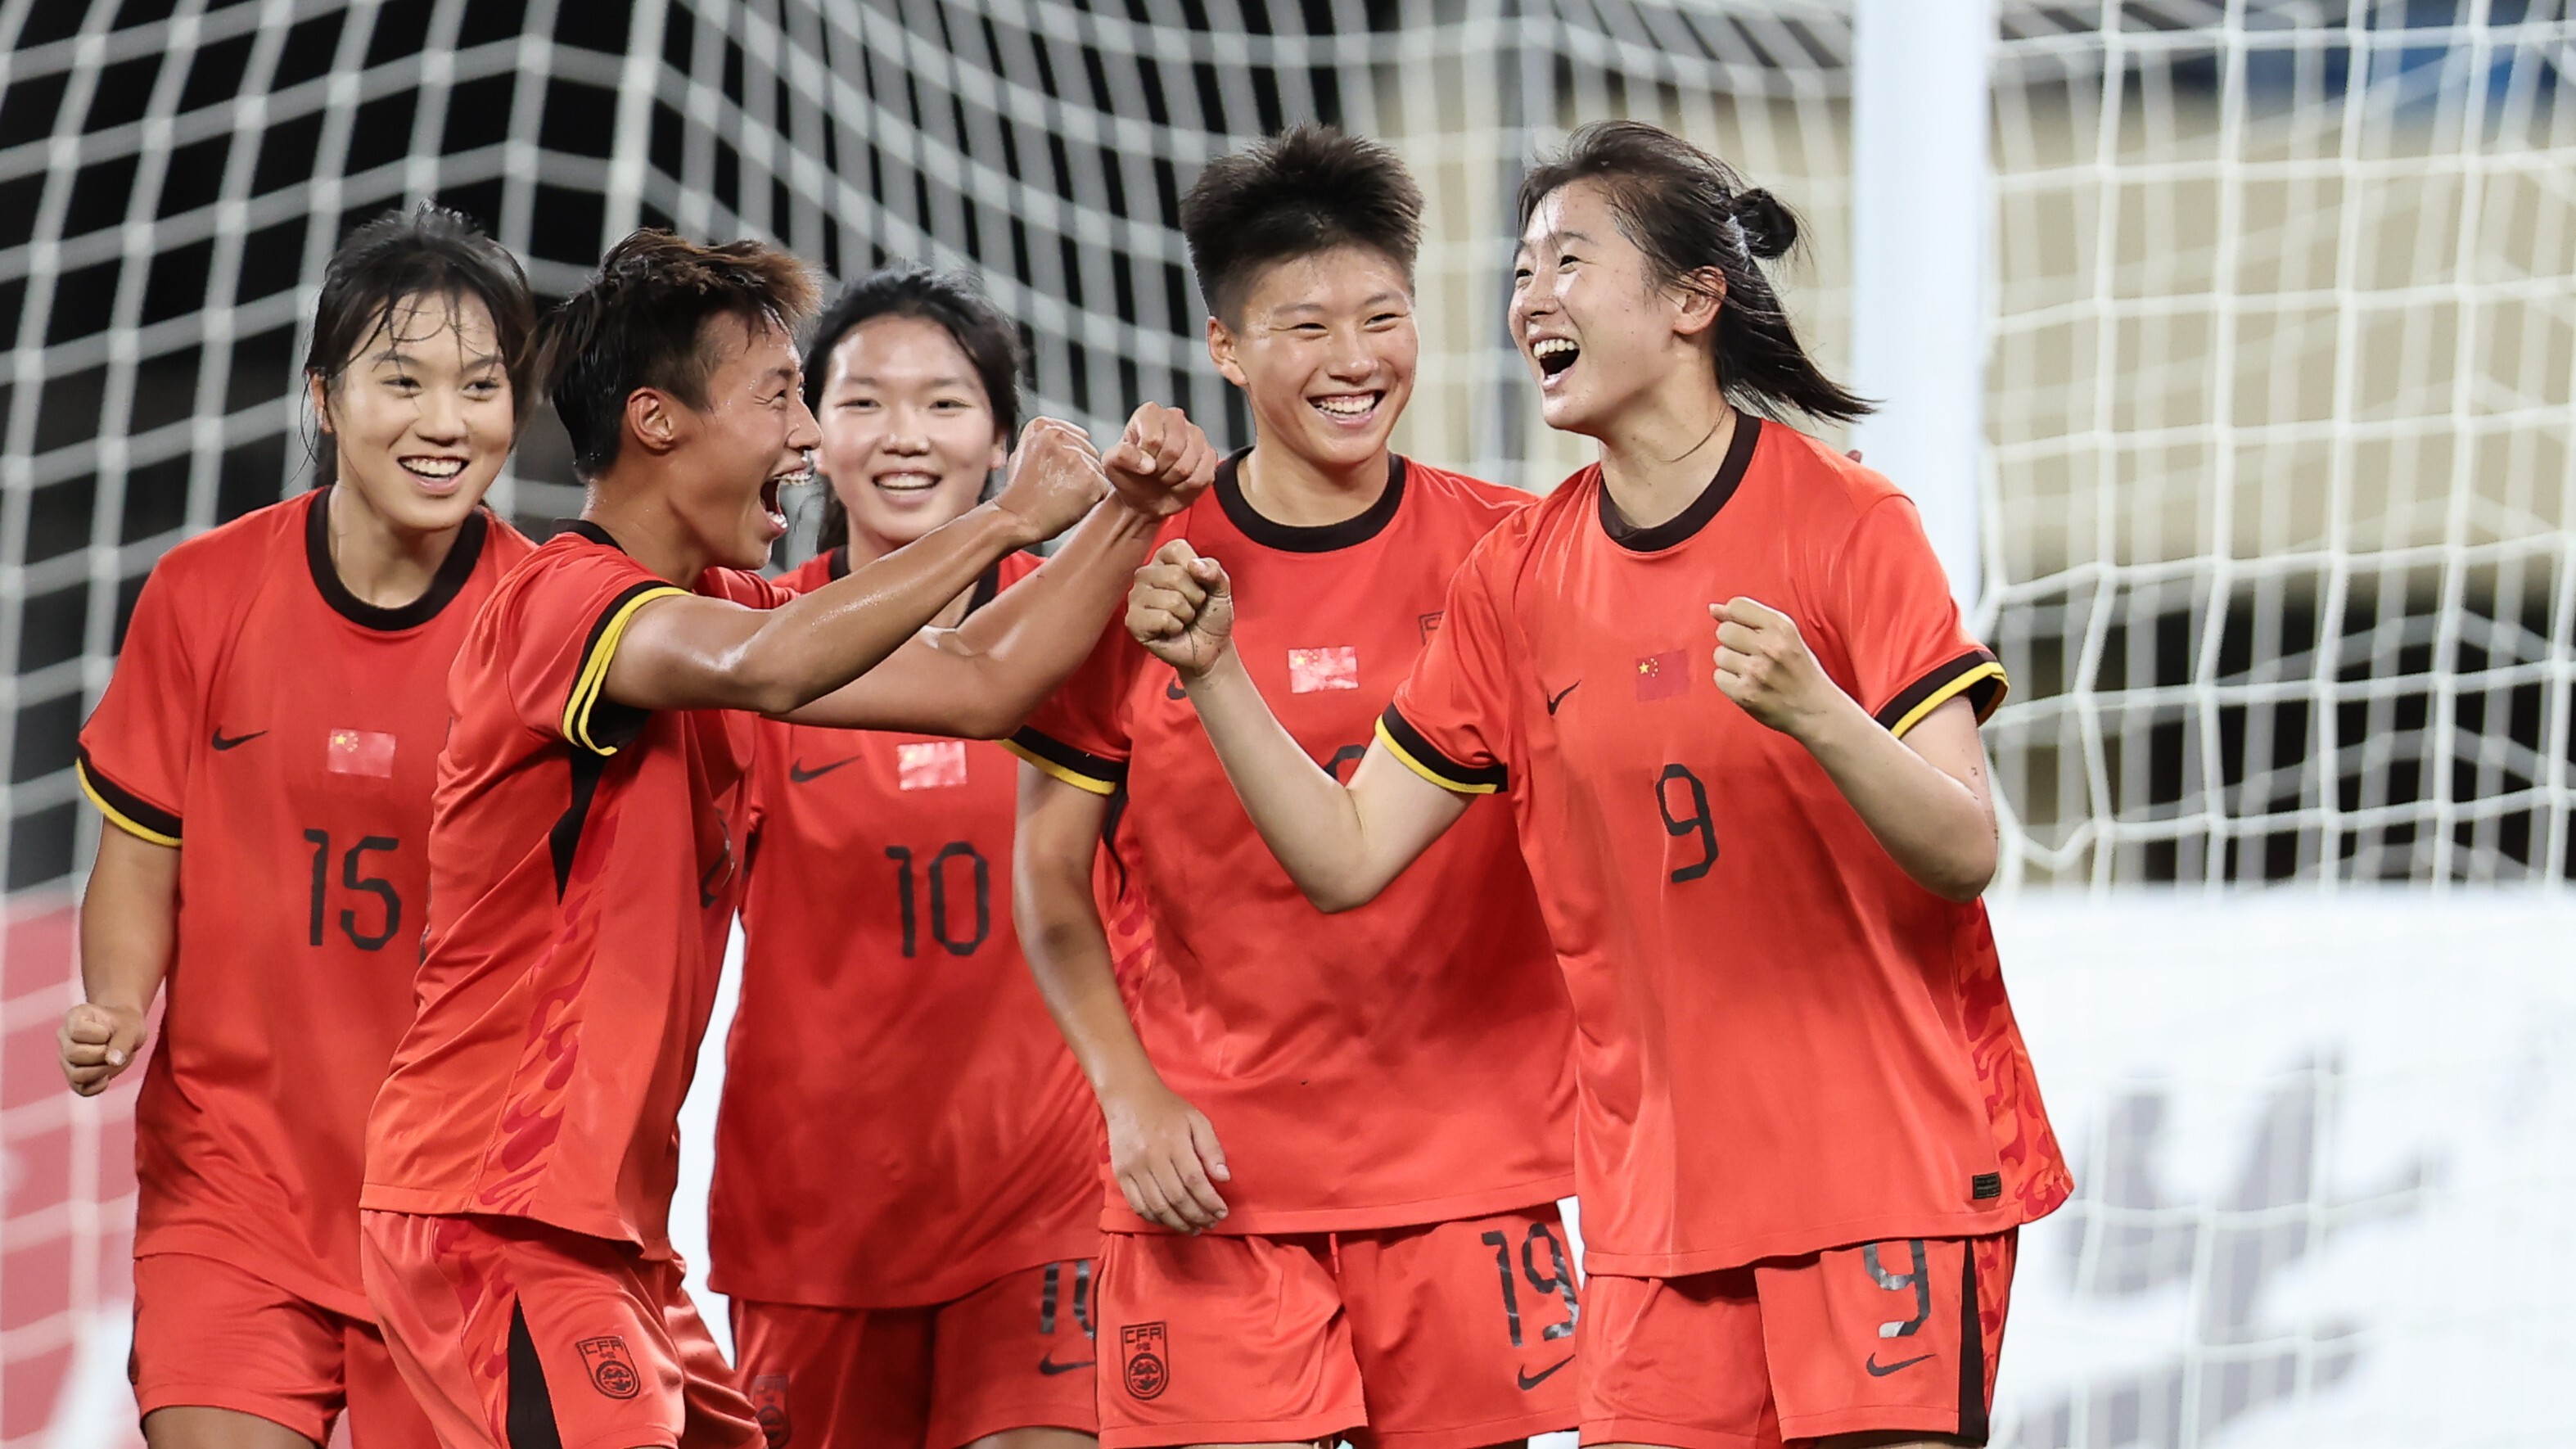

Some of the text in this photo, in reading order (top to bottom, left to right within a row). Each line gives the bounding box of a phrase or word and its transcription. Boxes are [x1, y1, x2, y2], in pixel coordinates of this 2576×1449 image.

[1656, 763, 1718, 883] 9
[304, 828, 402, 951] 15
[886, 842, 990, 958] 10
[1482, 1222, 1580, 1347] 19
[1863, 1240, 1931, 1338] 9
